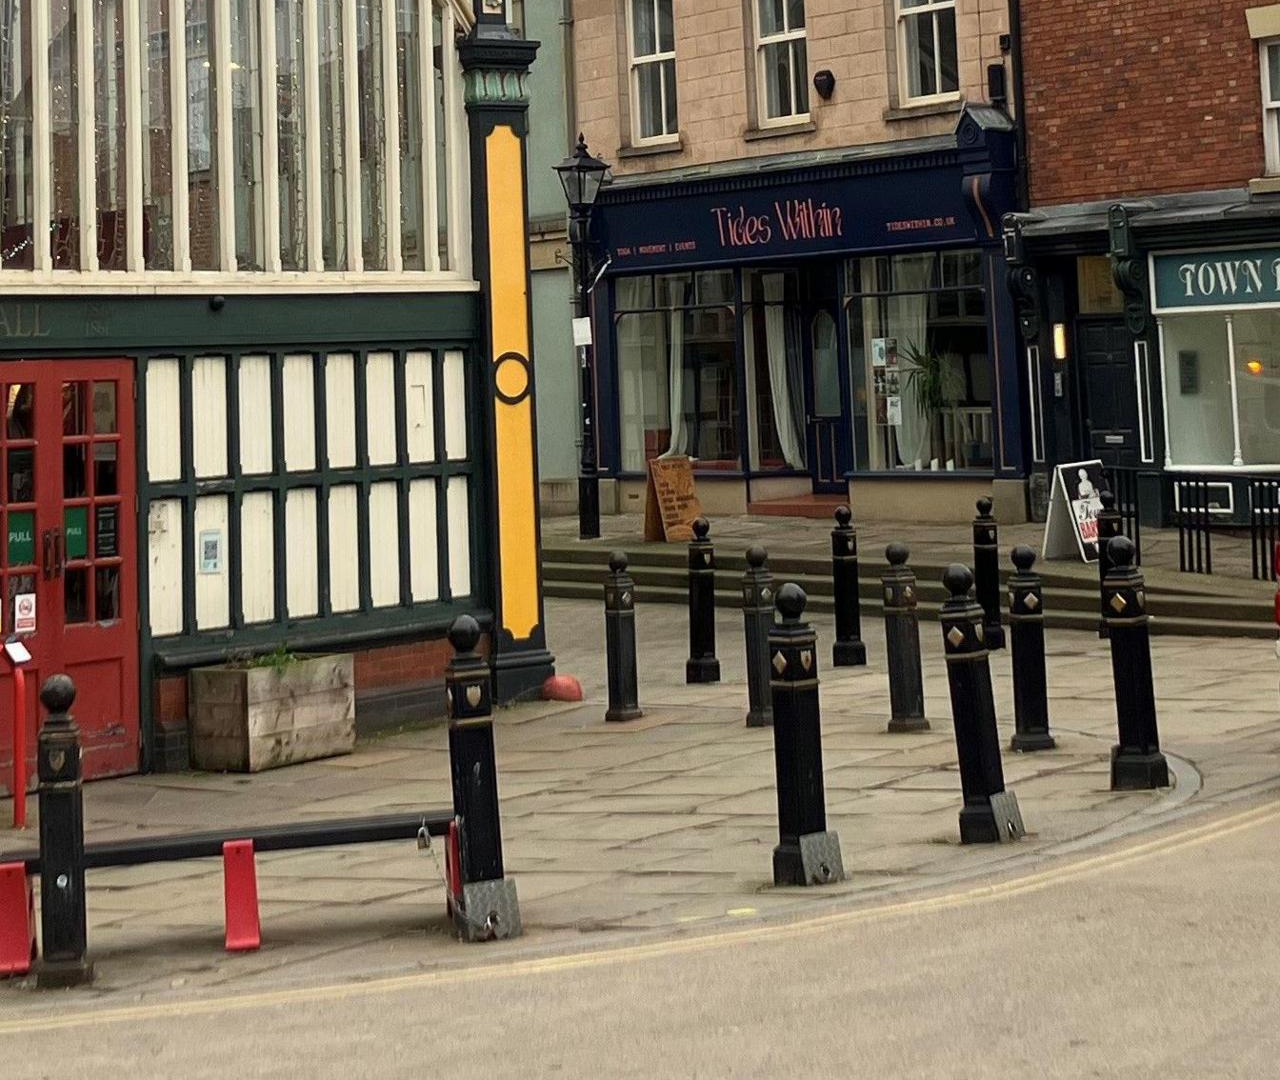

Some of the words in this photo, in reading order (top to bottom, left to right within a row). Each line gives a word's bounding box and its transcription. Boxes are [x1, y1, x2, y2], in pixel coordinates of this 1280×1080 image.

[710, 204, 772, 247] Tides
[775, 197, 844, 240] Within
[1178, 258, 1265, 297] TOWN
[8, 531, 33, 544] PULL
